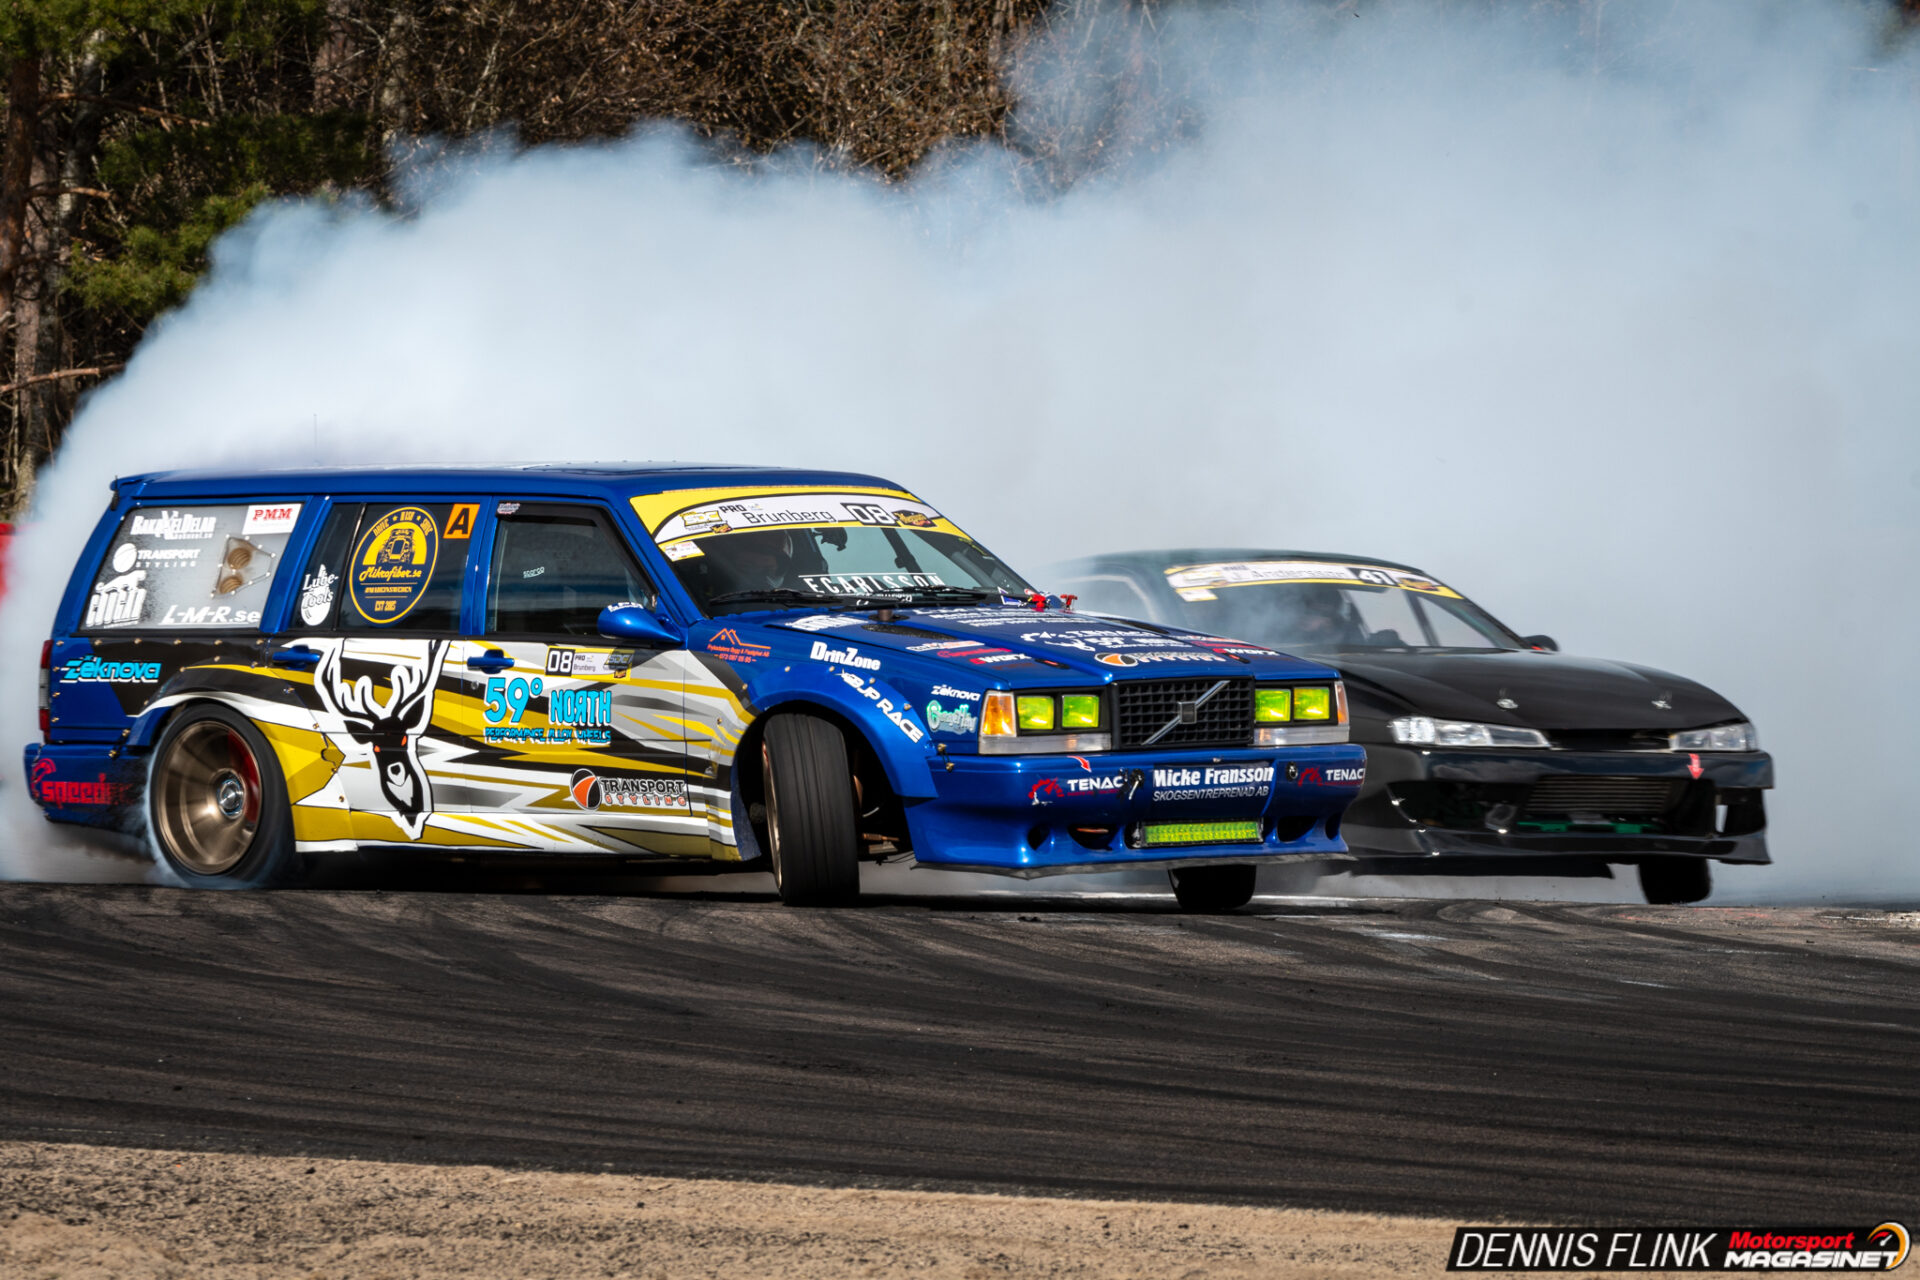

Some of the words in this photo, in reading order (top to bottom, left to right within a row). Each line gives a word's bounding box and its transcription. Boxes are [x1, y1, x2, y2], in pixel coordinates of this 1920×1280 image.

[252, 507, 294, 521] PMM
[447, 507, 470, 536] A
[742, 509, 838, 524] Brunberg
[846, 504, 896, 524] 08
[137, 548, 201, 560] TRANSPORT
[547, 650, 574, 673] 08
[876, 698, 925, 744] RACE
[575, 730, 612, 746] WHEELS
[1153, 768, 1202, 788] Micke
[1204, 766, 1275, 785] Fransson
[1325, 767, 1366, 782] TENAC
[600, 778, 685, 794] TRANSPORT
[1067, 775, 1124, 792] TENAC
[605, 793, 687, 806] STYLING
[1153, 787, 1256, 802] SKOGSENTREPRENAD
[1255, 785, 1270, 797] AB
